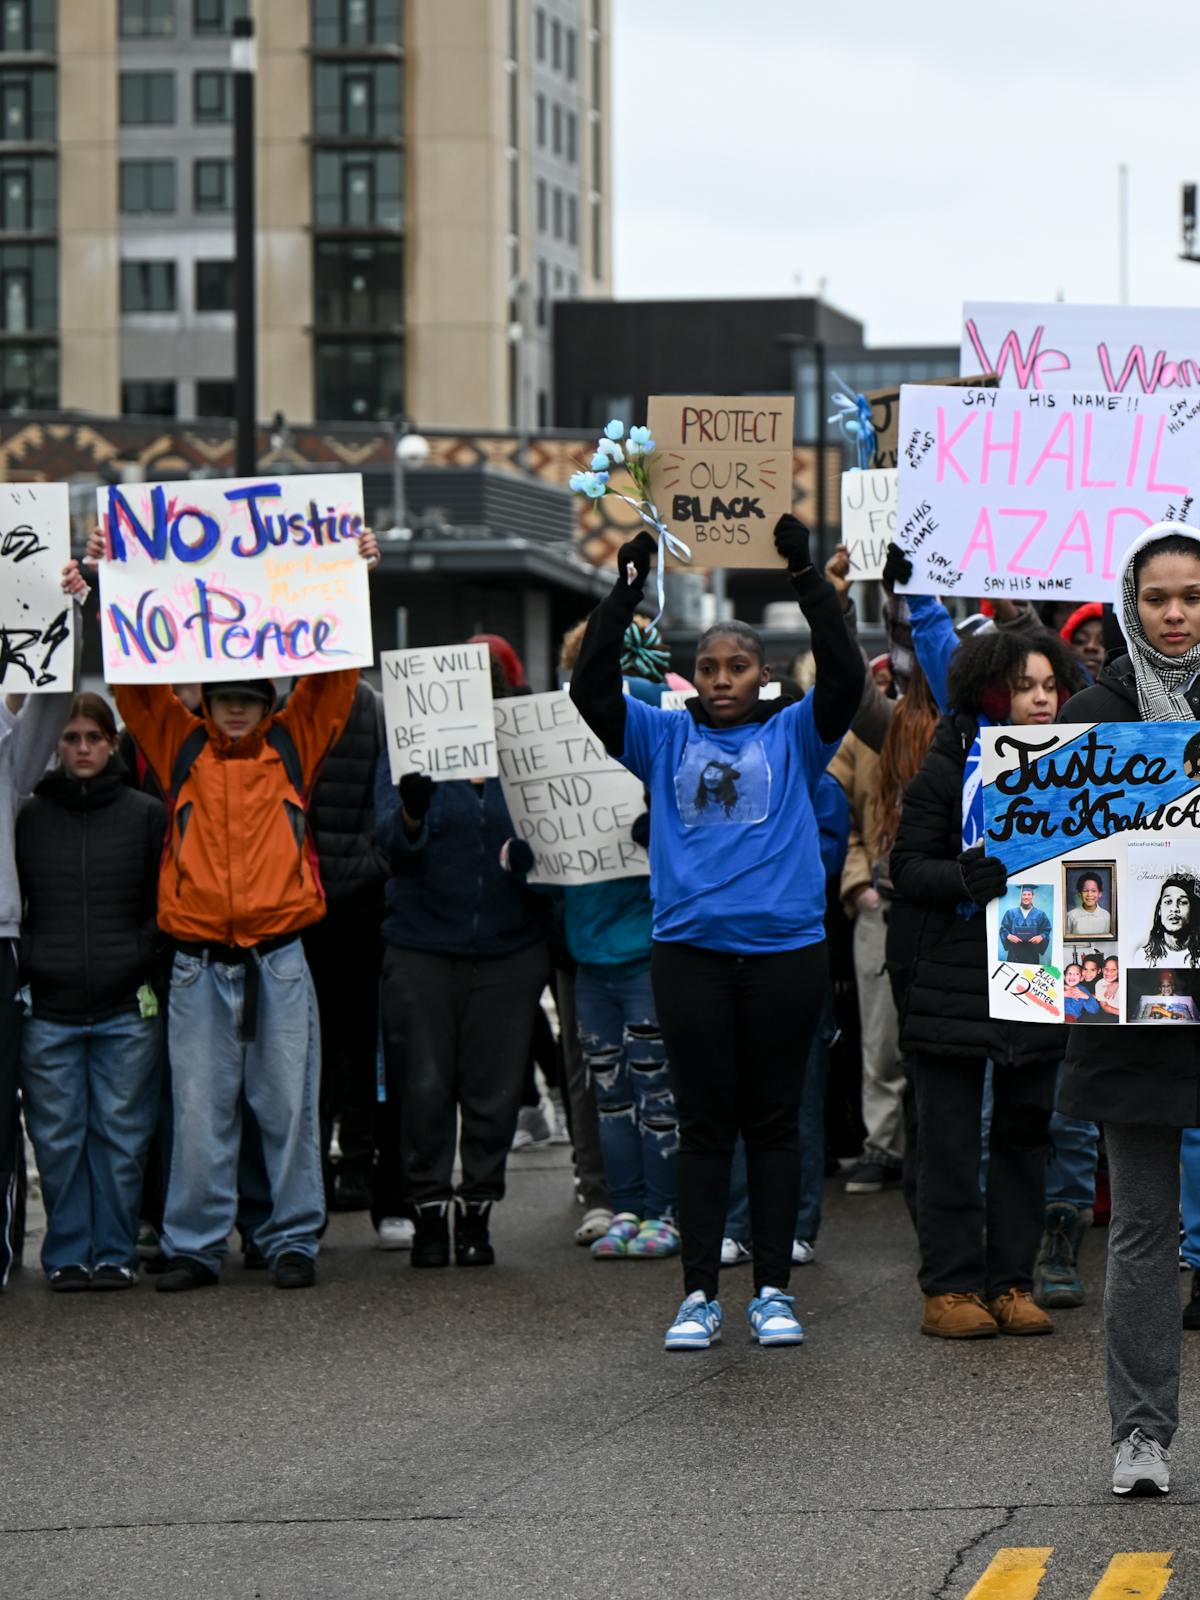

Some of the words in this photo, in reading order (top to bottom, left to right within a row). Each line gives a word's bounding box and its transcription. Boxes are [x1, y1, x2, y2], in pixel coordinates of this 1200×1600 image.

[966, 318, 1071, 390] We
[962, 389, 998, 408] SAY
[1029, 393, 1056, 408] HIS
[1170, 398, 1187, 416] SAY
[682, 407, 783, 445] PROTECT
[921, 431, 935, 453] SAY
[1168, 419, 1185, 434] HIS
[905, 428, 921, 459] NAME
[936, 406, 1189, 496] KHALIL
[690, 461, 755, 489] OUR
[224, 483, 363, 557] Justice
[672, 494, 766, 523] BLACK
[900, 519, 916, 544] SAY
[913, 499, 932, 523] HIS
[695, 523, 750, 545] BOYS
[904, 517, 939, 558] NAME
[959, 505, 1153, 580] AZAD
[927, 552, 951, 567] SAY
[928, 570, 956, 588] NAME
[984, 577, 1005, 592] SAY
[1009, 576, 1031, 591] HIS
[1038, 577, 1072, 590] NAME
[385, 654, 426, 680] WE
[433, 651, 488, 673] WILL
[406, 679, 470, 718] NOT
[494, 698, 581, 741] RELE
[394, 724, 426, 749] BE
[408, 740, 495, 773] SILENT
[497, 743, 549, 778] THE
[994, 731, 1177, 795] Justice
[520, 775, 592, 814] END
[518, 802, 634, 845] POLICE
[987, 796, 1058, 842] for
[1062, 789, 1167, 839] Khalil
[533, 839, 647, 879] MURDER
[1031, 976, 1049, 992] LIVES
[1035, 967, 1056, 987] BLACK
[1031, 986, 1054, 1005] MATTER
